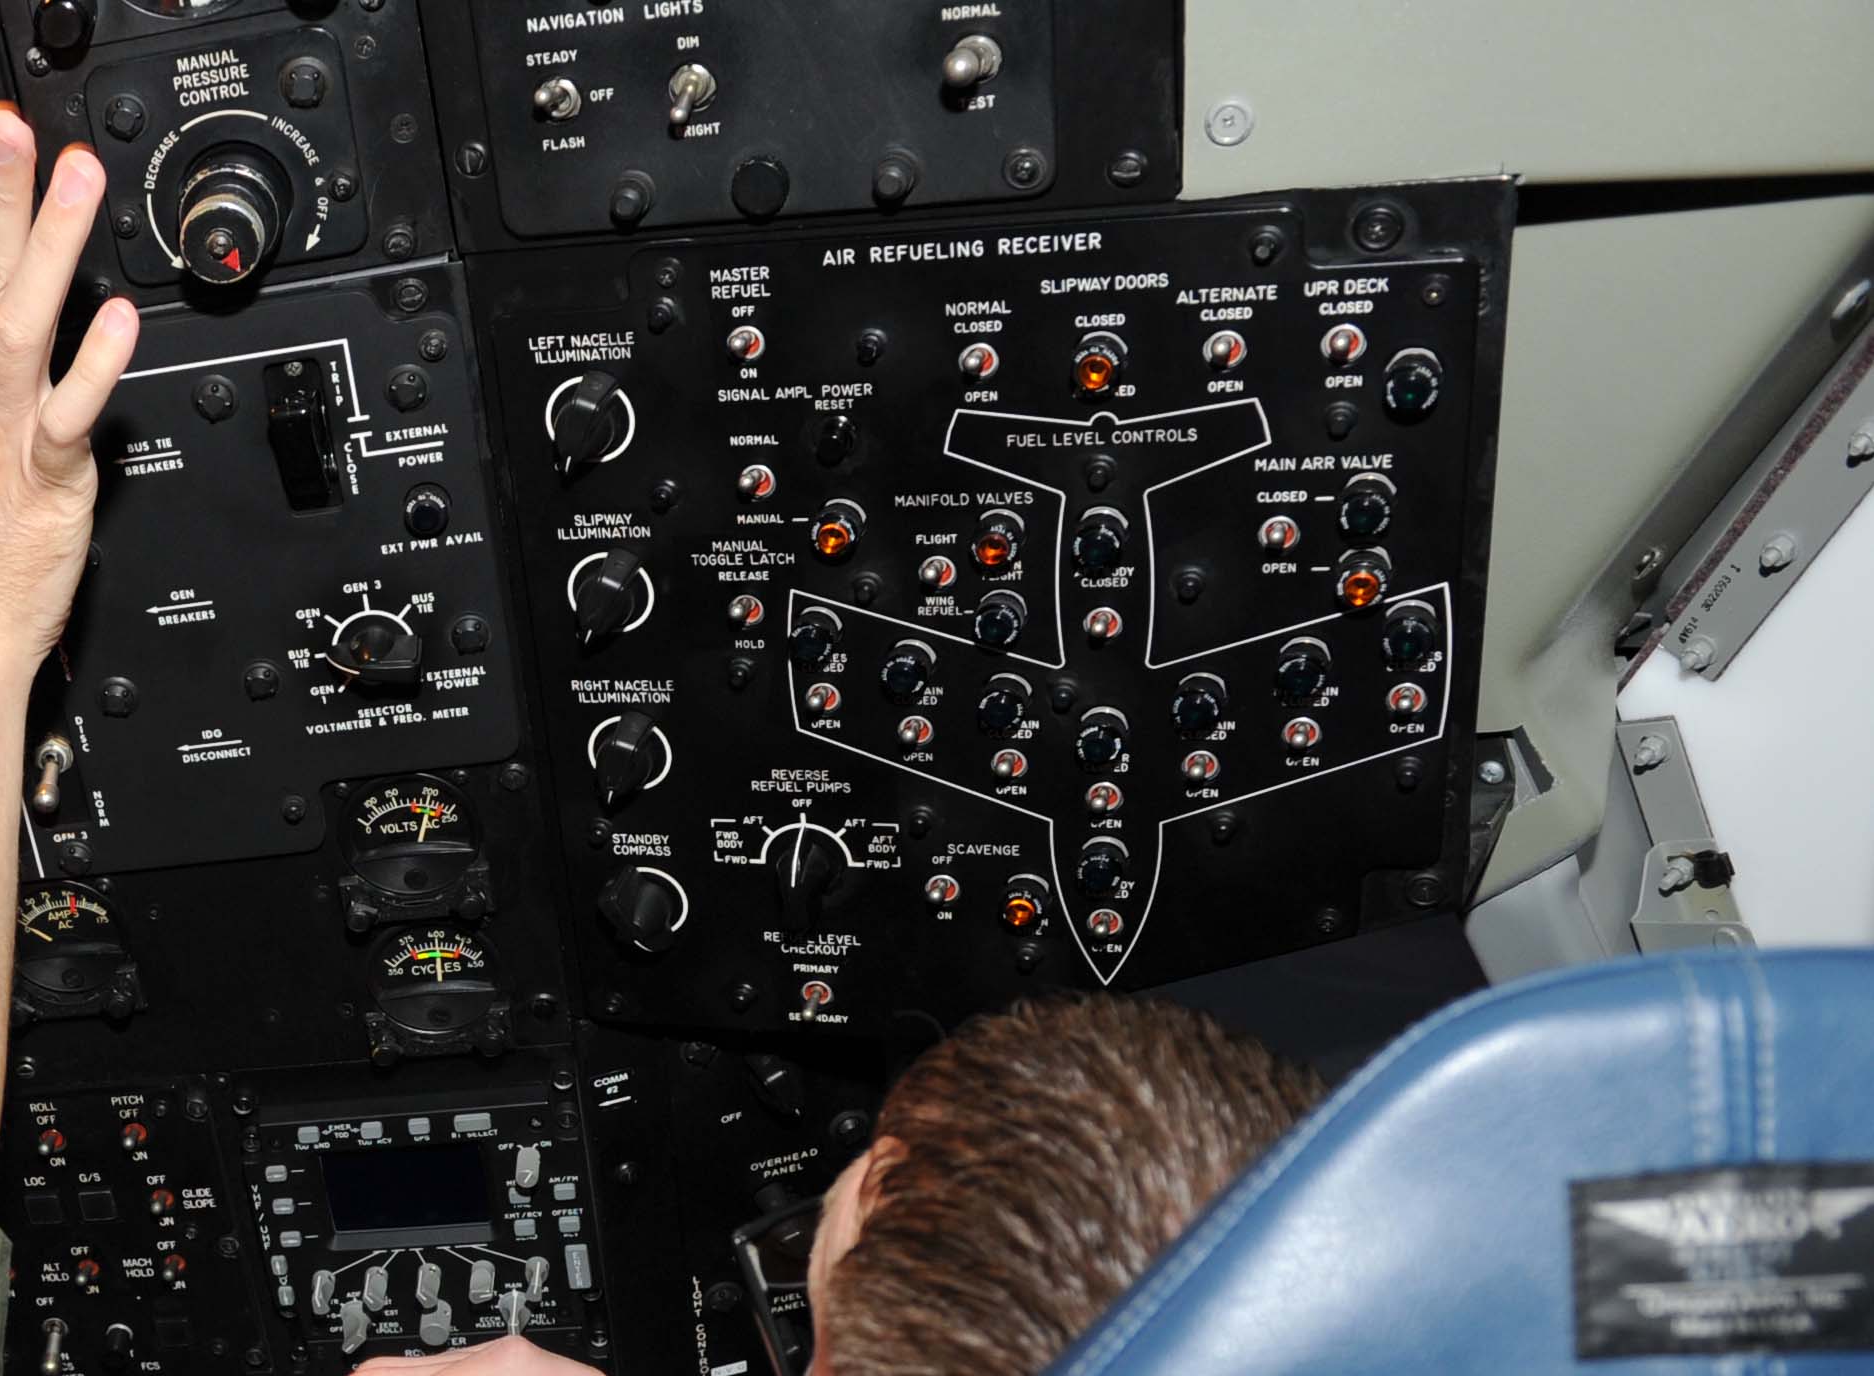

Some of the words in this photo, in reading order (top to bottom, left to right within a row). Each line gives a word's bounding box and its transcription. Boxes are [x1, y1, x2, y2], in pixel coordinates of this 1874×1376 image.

[526, 7, 625, 33] NAVIGATION
[643, 0, 704, 20] LIGHTS
[676, 35, 700, 51] DIM
[176, 48, 240, 73] MANUAL
[525, 48, 578, 67] STEADY
[172, 63, 250, 96] PRESSURE
[179, 81, 250, 107] CONTROL
[542, 135, 586, 152] FLASH
[143, 130, 180, 190] DECREASE
[270, 115, 320, 167] INCREASE
[316, 196, 329, 221] OFF
[822, 248, 856, 267] AIR
[869, 239, 985, 264] REFUELING
[997, 231, 1102, 256] RECEIVER
[709, 265, 770, 283] MASTER
[711, 282, 772, 300] REFUEL
[1040, 275, 1112, 295] SLIPWAY
[1114, 272, 1170, 291] DOORS
[1303, 279, 1340, 298] UPR
[1343, 277, 1390, 296] DECK
[1175, 284, 1279, 305] ALTERNATE
[528, 335, 565, 351] LEFT
[570, 331, 635, 348] NACELLE
[534, 346, 632, 365] ILLUMINATION
[329, 360, 344, 407] TRIP
[717, 387, 771, 403] SIGNAL
[774, 385, 813, 400] AMPL
[821, 382, 873, 398] POWER
[814, 398, 855, 411] RESET
[385, 423, 449, 443] EXTERNAL
[1006, 433, 1047, 448] FUEL
[1052, 431, 1106, 447] LEVEL
[1111, 427, 1198, 445] CONTROLS
[124, 457, 184, 477] BREAKERS
[397, 451, 444, 468] POWER
[1254, 457, 1297, 472] MAIN
[1300, 455, 1336, 471] ARR
[1340, 453, 1394, 470] VALVE
[343, 441, 360, 495] CLOSE
[894, 492, 970, 507] MANIFOLD
[976, 491, 1034, 506] VALVES
[573, 513, 633, 527] SLIPWAY
[736, 513, 785, 525] MANUAL
[557, 525, 651, 541] ILLUMINATION
[915, 533, 958, 545] FLIGHT
[380, 542, 404, 555] EXT
[409, 537, 439, 551] PWR
[445, 531, 484, 546] AVAIL
[711, 539, 769, 553] MANUAL
[690, 553, 744, 567] TOGGLE
[749, 552, 795, 566] LATCH
[717, 570, 770, 582] RELEASE
[342, 581, 369, 594] GEN
[373, 579, 382, 590] 3
[169, 588, 195, 602] GEN
[925, 596, 955, 606] WING
[157, 609, 216, 626] BREAKERS
[295, 608, 321, 620] GEN
[918, 606, 963, 616] REFUEL
[734, 639, 765, 650] HOLD
[426, 664, 487, 684] EXTERNAL
[309, 684, 335, 697] GEN
[435, 676, 479, 691] POWER
[570, 679, 611, 692] RIGHT
[614, 679, 675, 692] NACELLE
[578, 691, 671, 704] ILLUMINATION
[357, 703, 413, 719] SELECTOR
[201, 728, 223, 740] IDG
[181, 746, 251, 764] DISCONNECT
[771, 768, 830, 782] REVERSE
[750, 780, 803, 793] REFUEL
[806, 781, 852, 794] PUMPS
[92, 790, 110, 828] NORM
[611, 832, 670, 846] STANDBY
[612, 844, 672, 857] COMPASS
[947, 843, 1021, 857] SCAVENGE
[792, 963, 839, 974] PRIMARY
[593, 1072, 629, 1088] COMM
[29, 1101, 58, 1113] ROLL
[110, 1094, 145, 1107] PITCH
[749, 1147, 819, 1175] OVERHEAD
[78, 1172, 102, 1183] G/S
[763, 1162, 804, 1179] PANEL
[23, 1175, 47, 1187] LOC
[181, 1187, 213, 1199] GLIDE
[182, 1198, 217, 1210] SLOPE
[552, 1208, 584, 1217] OFFSET
[42, 1262, 60, 1273] ALT
[122, 1257, 153, 1268] MACH
[40, 1272, 70, 1283] HOLD
[125, 1267, 155, 1278] HOLD
[692, 1275, 703, 1318] LIGHT
